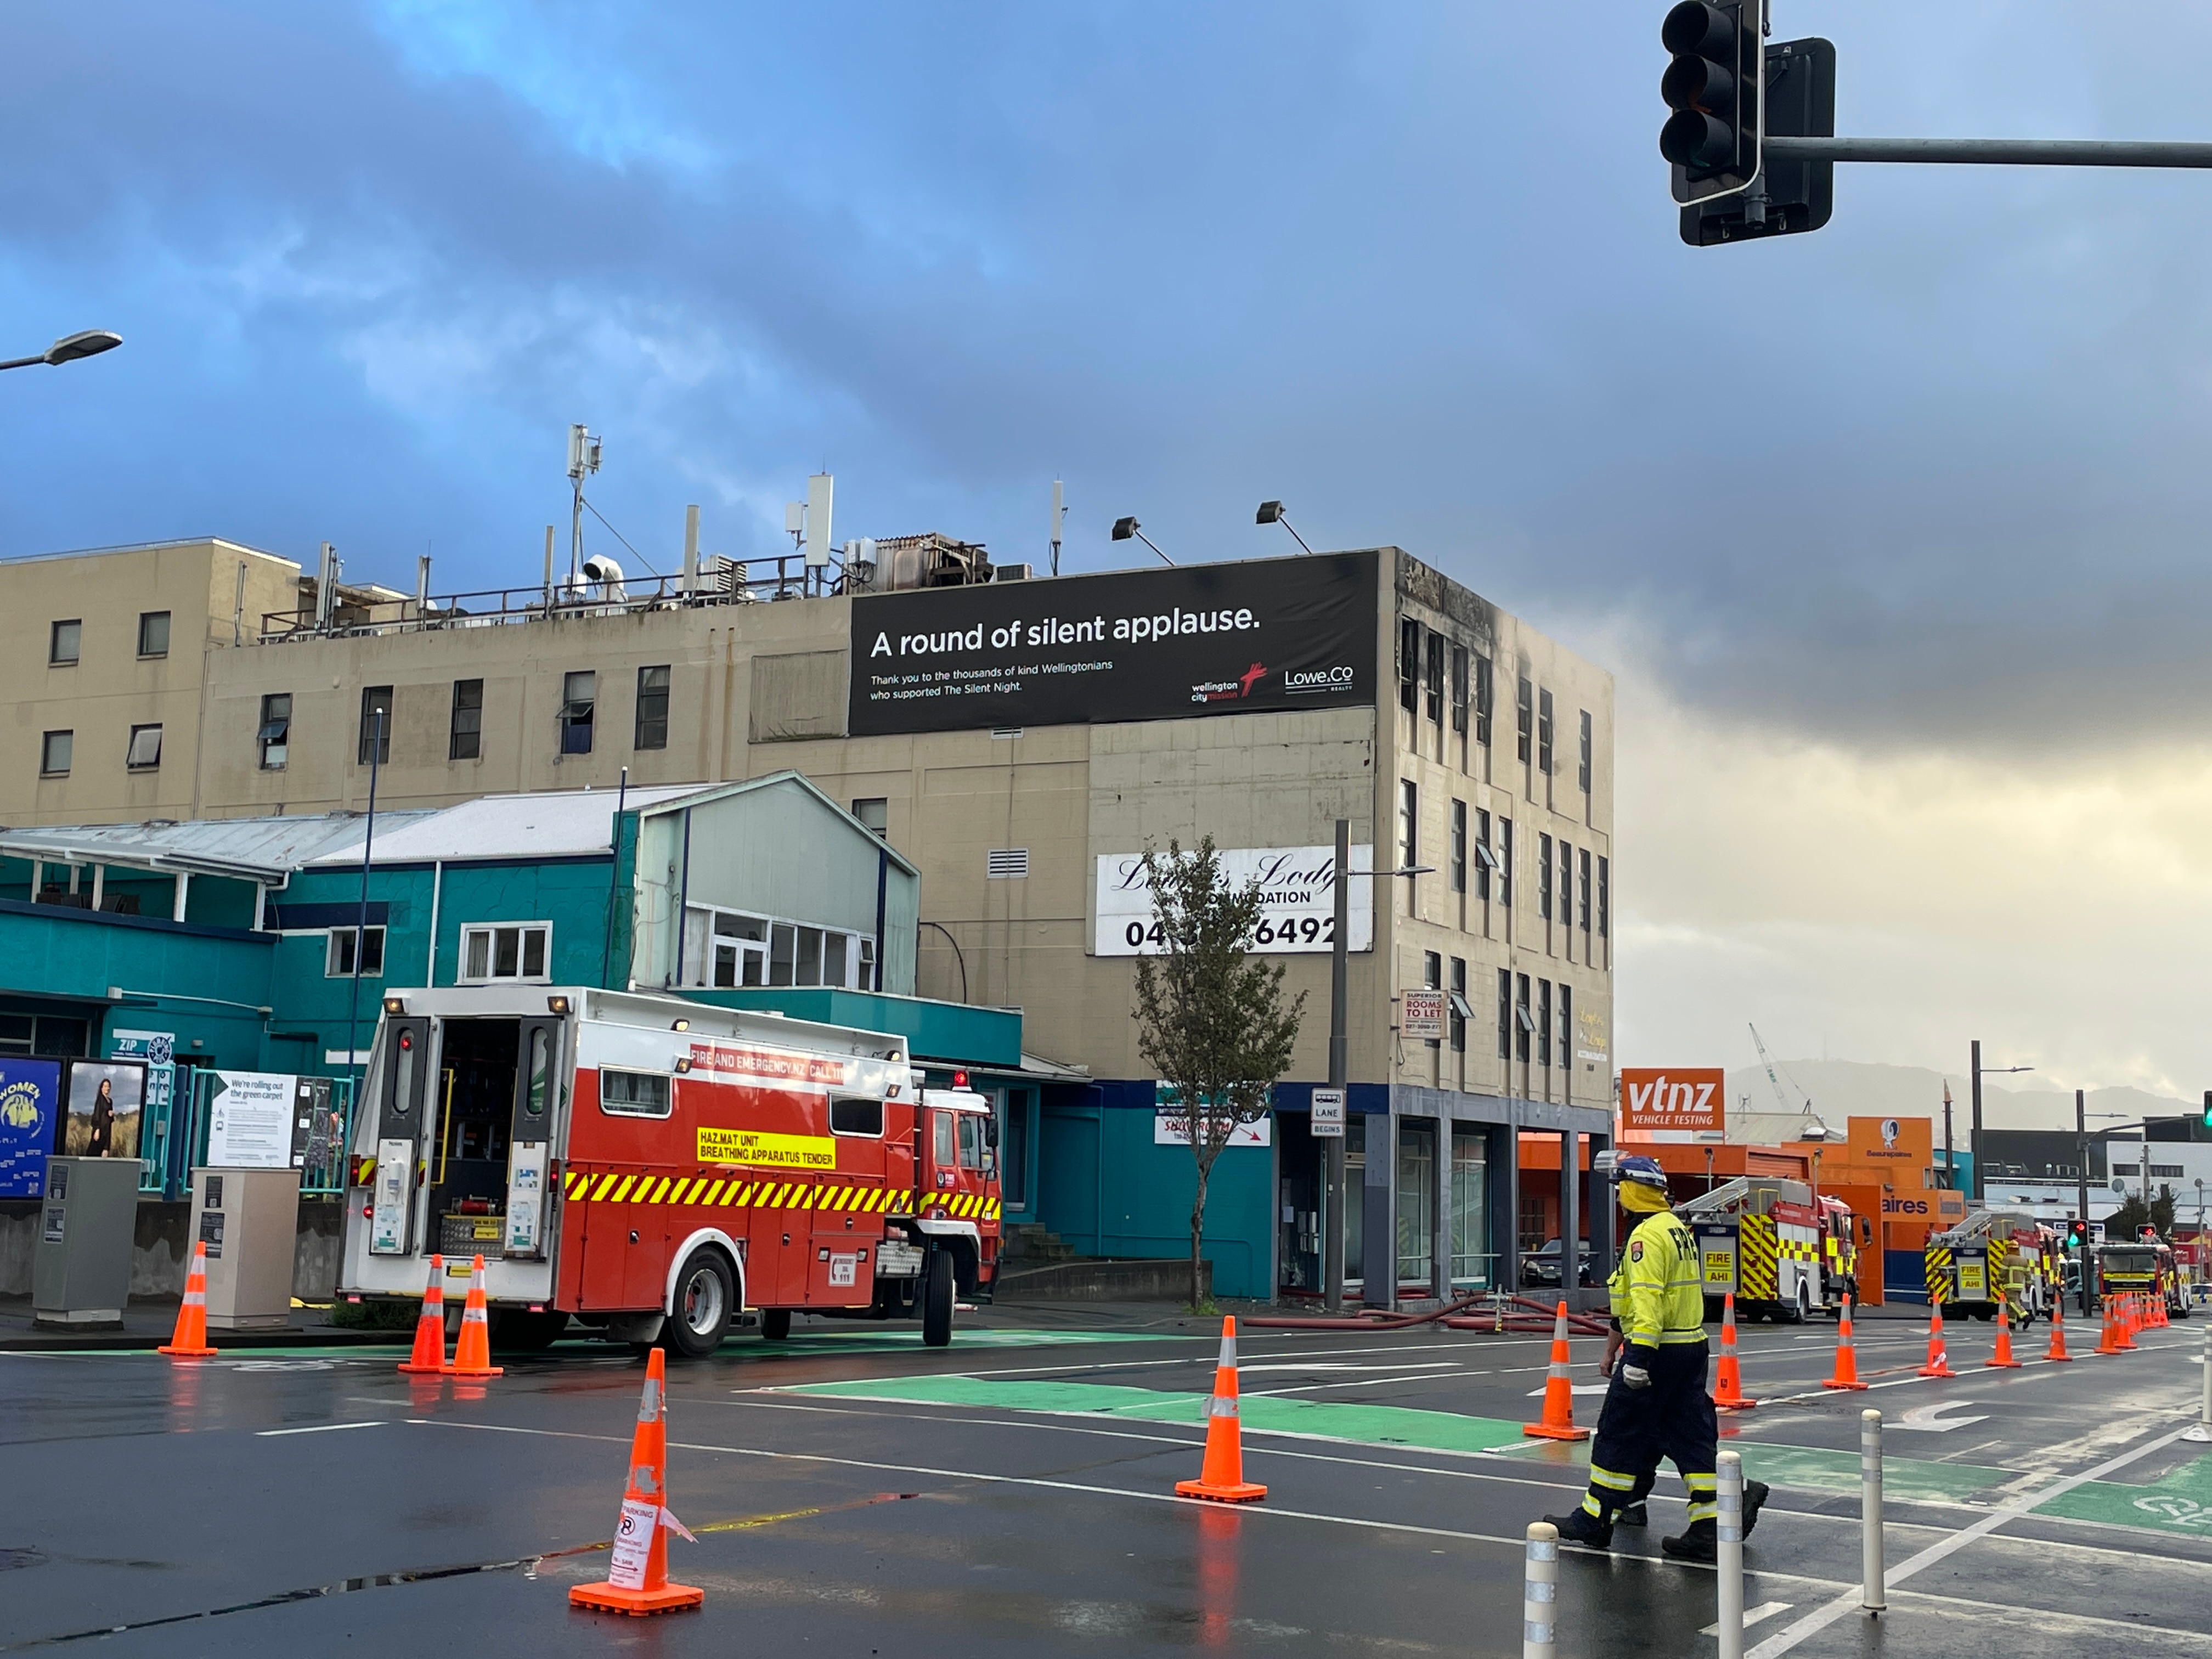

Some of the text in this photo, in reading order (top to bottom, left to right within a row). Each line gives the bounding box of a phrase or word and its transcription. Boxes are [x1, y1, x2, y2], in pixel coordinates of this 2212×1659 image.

[870, 607, 1260, 657] A round of silent applause.
[871, 660, 1113, 686] Thank you to the thousands of kind Wellingtonians
[870, 681, 1023, 701] who supported The Silent Night.
[1191, 681, 1238, 692] wellington
[1406, 1009, 1442, 1018] TO LET
[119, 1039, 138, 1051] ZIP
[714, 1053, 735, 1068] AND
[810, 1065, 831, 1079] CALL
[0, 1081, 41, 1101] WOMEN
[1628, 1075, 1717, 1112] vtnz
[1316, 1109, 1338, 1117] LANE
[1632, 1115, 1713, 1125] VEHICLE TESTING
[741, 1135, 759, 1147] UNIT
[700, 1145, 833, 1165] BREATHING APPARATUS TENDER
[1706, 1253, 1731, 1263] FIRE
[1961, 1266, 1981, 1274] FIRE
[839, 1273, 850, 1282] 111
[1710, 1272, 1728, 1281] AHI
